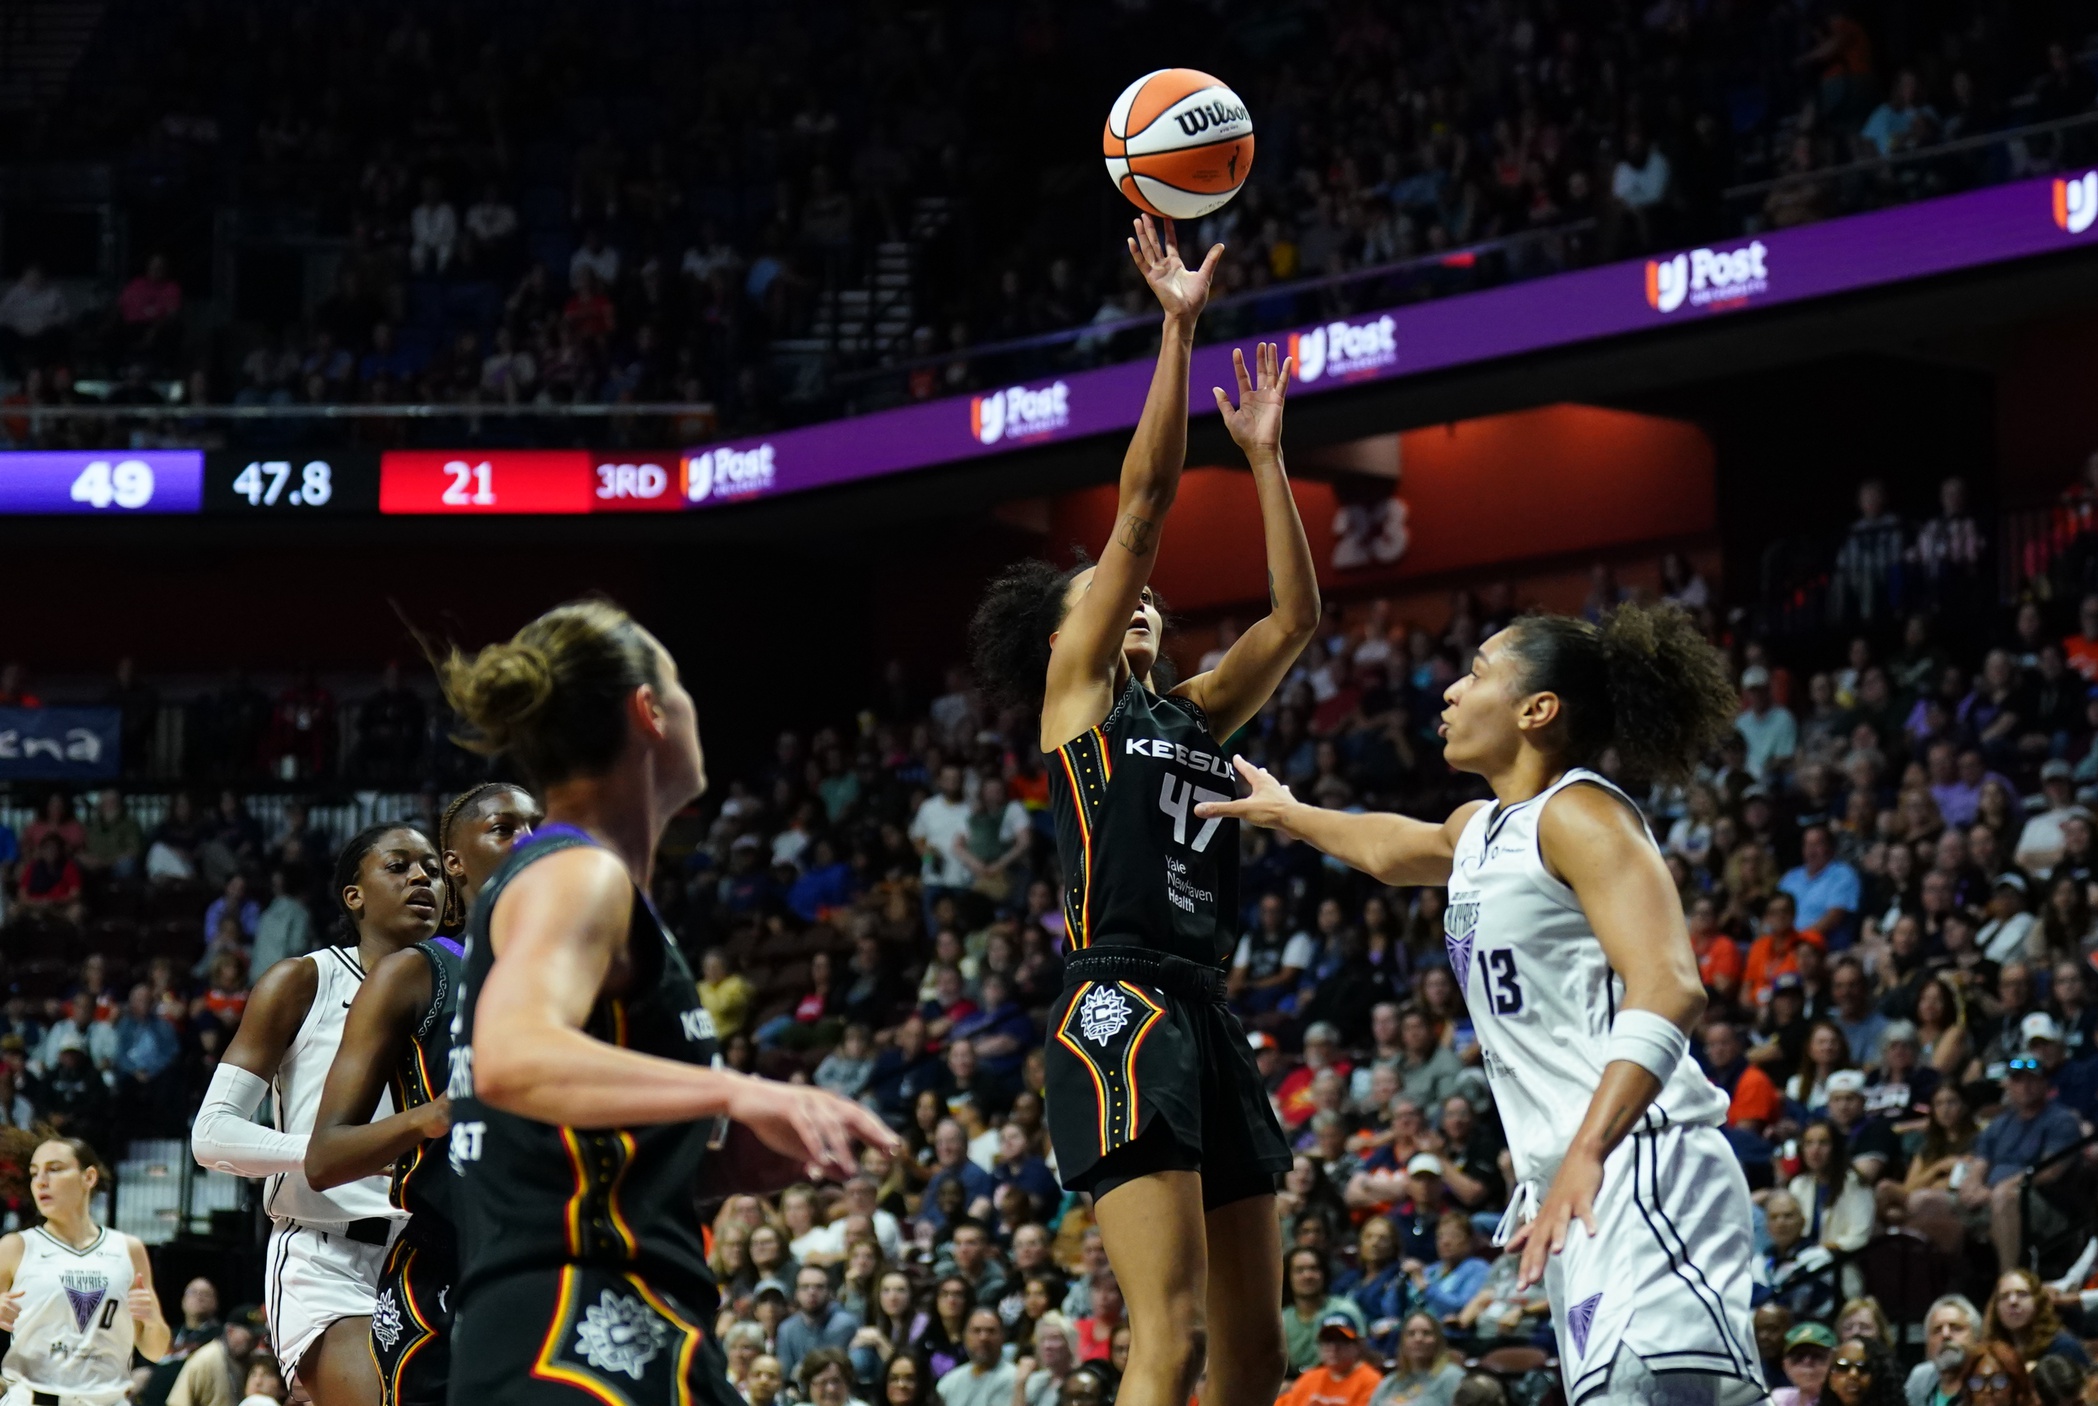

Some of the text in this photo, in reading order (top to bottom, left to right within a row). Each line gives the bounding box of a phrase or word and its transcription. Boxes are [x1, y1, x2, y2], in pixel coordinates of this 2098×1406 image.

[1689, 240, 1767, 290] Post
[1326, 314, 1397, 362] Post
[1005, 380, 1069, 425] Post
[70, 459, 155, 509] 49
[232, 460, 332, 506] 47.8
[442, 460, 497, 506] 21
[596, 463, 668, 500] 3RD
[713, 443, 776, 484] Post
[1331, 498, 1408, 569] 23
[1158, 771, 1231, 853] 47
[1165, 854, 1186, 875] Yale
[1168, 886, 1195, 914] Health
[1477, 948, 1524, 1016] 13
[99, 1298, 119, 1330] 0
